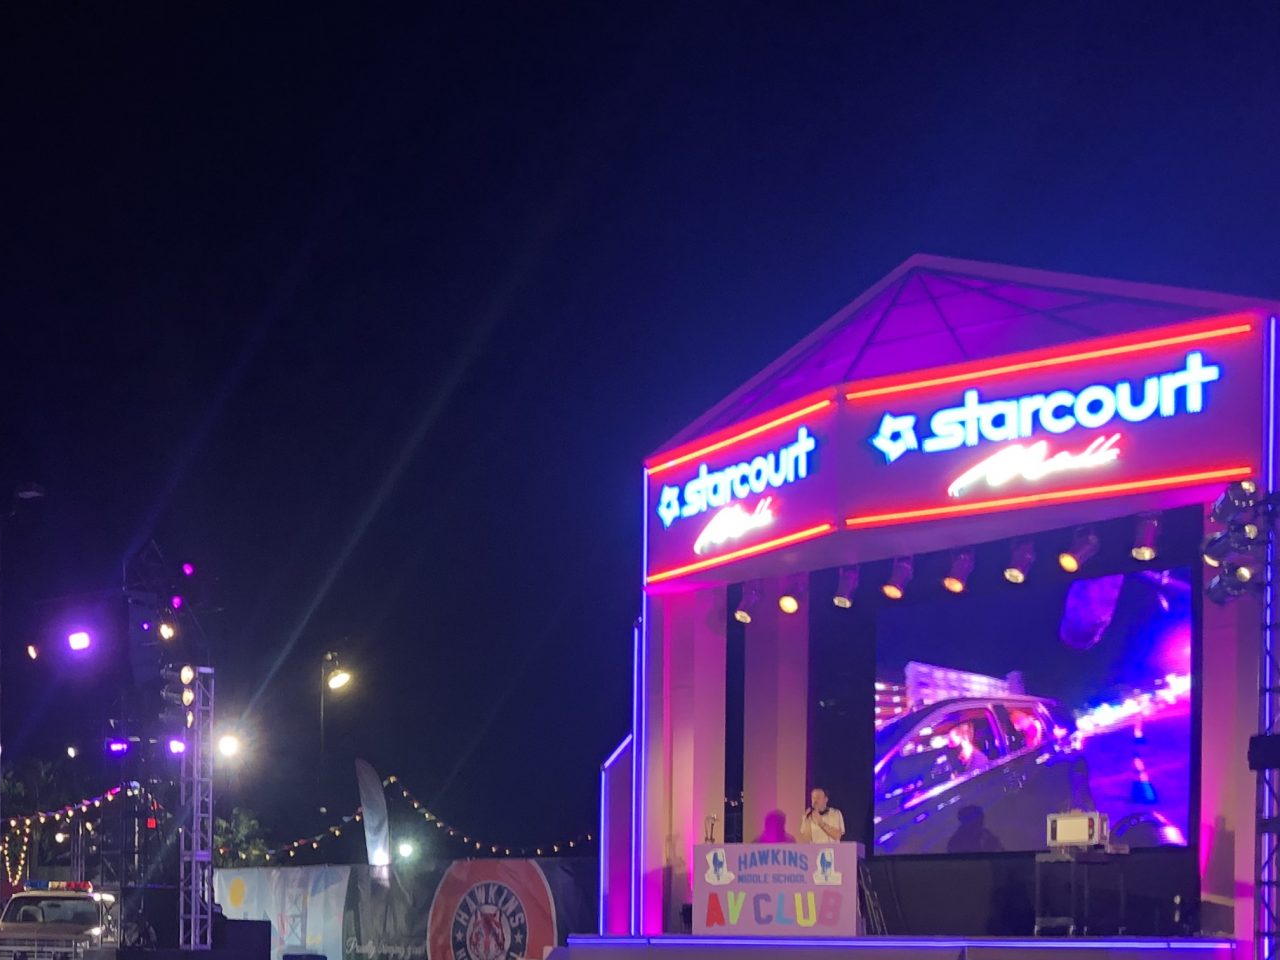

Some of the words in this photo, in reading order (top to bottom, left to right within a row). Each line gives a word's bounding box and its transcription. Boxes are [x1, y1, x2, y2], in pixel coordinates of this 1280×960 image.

[922, 351, 1220, 453] starcourt
[680, 426, 815, 519] starcourt
[737, 873, 768, 884] MIDDLE
[772, 873, 806, 884] SCHOOL
[738, 848, 809, 872] HAWKINS
[455, 883, 525, 928] HAWKINS
[705, 891, 746, 928] AV
[753, 891, 843, 928] CLUB
